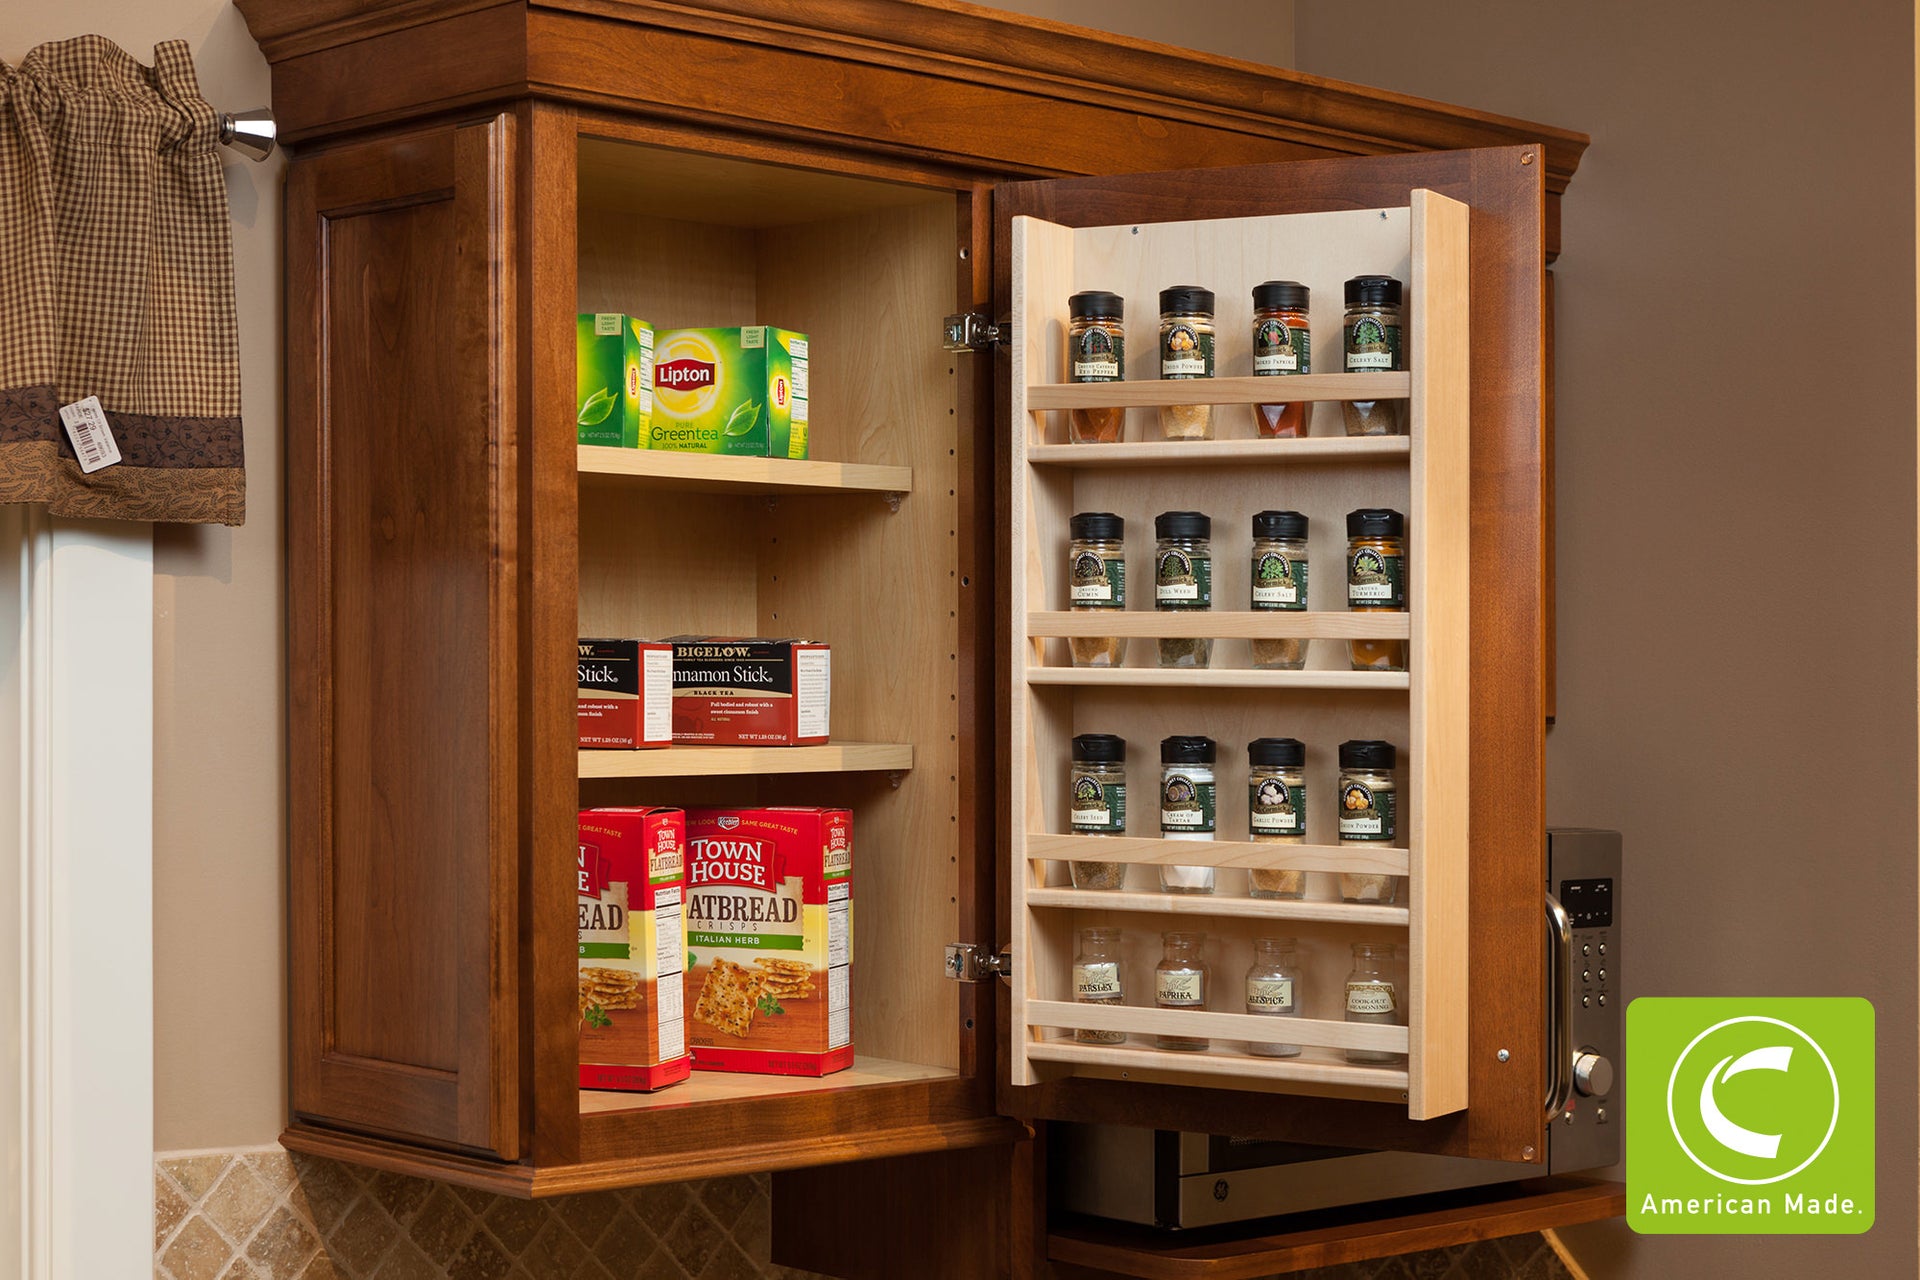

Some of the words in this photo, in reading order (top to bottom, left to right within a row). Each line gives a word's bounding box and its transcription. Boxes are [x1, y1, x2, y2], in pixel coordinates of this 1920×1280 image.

[660, 366, 710, 386] Lipton
[651, 426, 719, 441] Greentea
[677, 646, 749, 658] BIGELOW
[734, 665, 770, 682] Stick
[604, 829, 622, 838] TASTE
[657, 829, 675, 841] TOWN
[780, 826, 798, 835] TASTE
[830, 827, 845, 839] TOWN
[658, 840, 676, 853] HOUSE
[691, 839, 762, 862] TOWN
[691, 861, 765, 886] HOUSE
[686, 895, 798, 922] ATBREAD
[697, 921, 758, 931] CRISPS
[695, 935, 731, 944] ITALIAN
[1079, 983, 1113, 992] PARSLEY
[1159, 991, 1192, 999] PAPRIKA
[1248, 996, 1284, 1004] ALLSPICE
